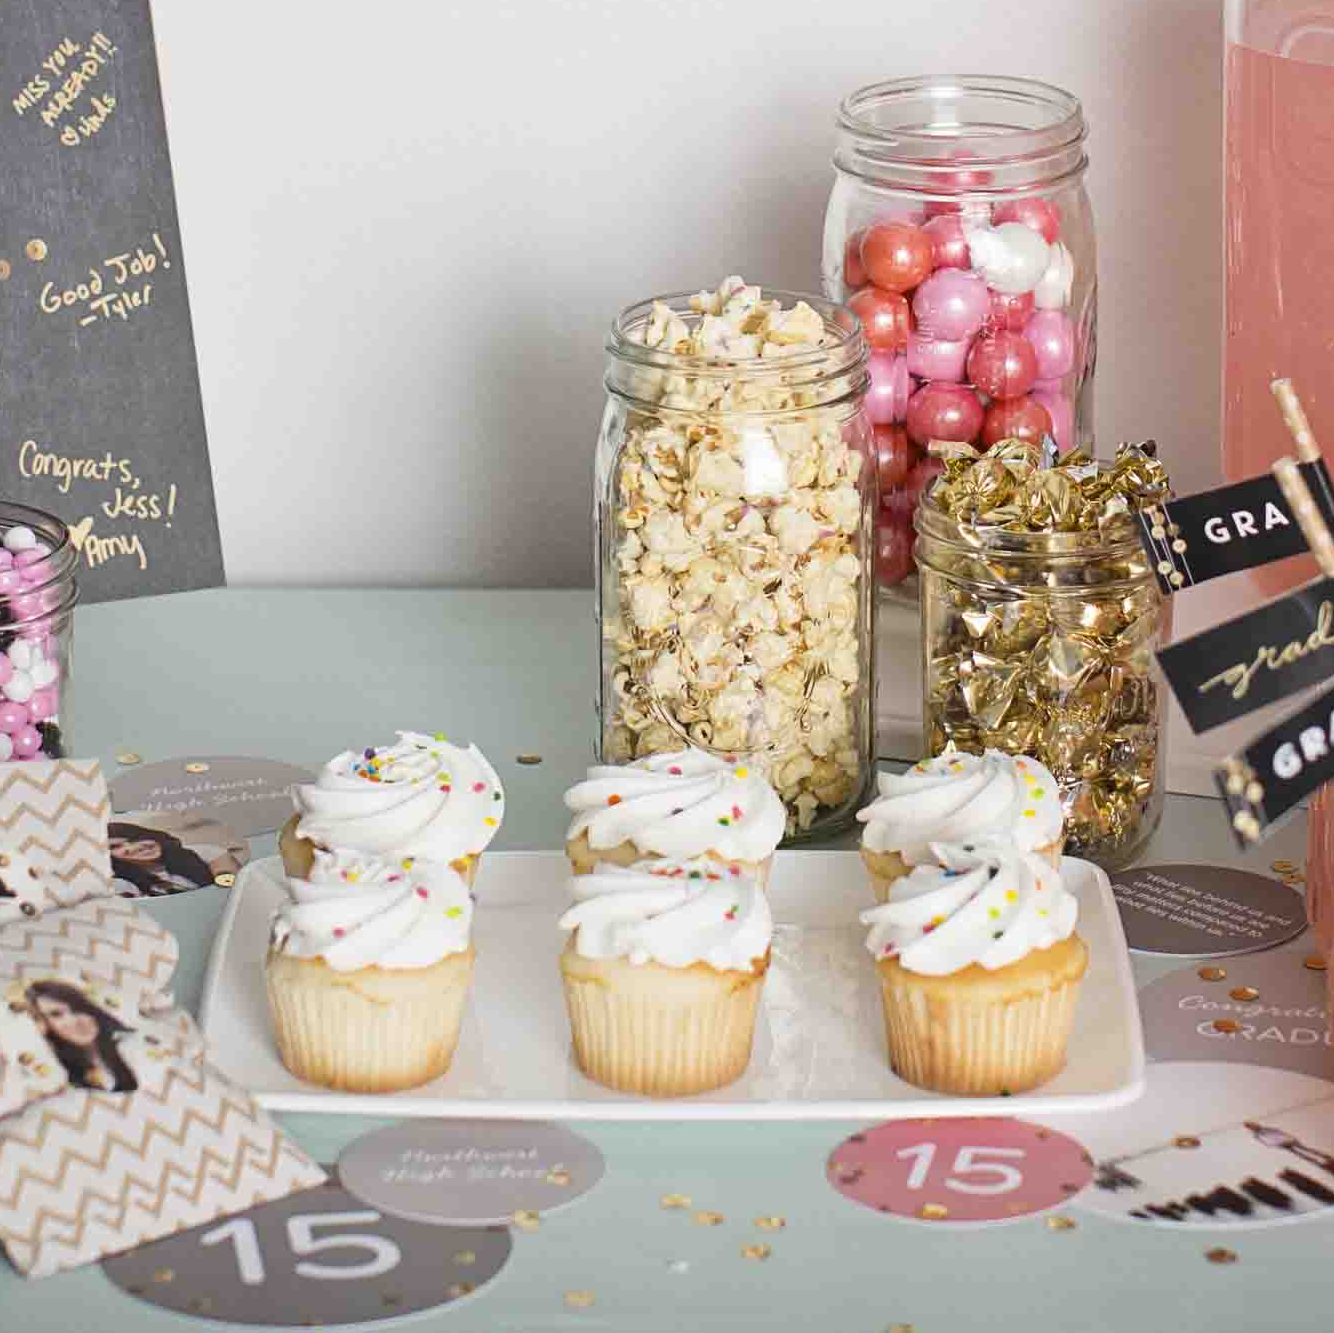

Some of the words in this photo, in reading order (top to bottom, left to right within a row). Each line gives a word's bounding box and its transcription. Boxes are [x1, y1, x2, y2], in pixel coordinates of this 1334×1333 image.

[12, 73, 50, 115] MISS
[41, 269, 102, 314] Good
[101, 483, 177, 528] Jess!
[1204, 501, 1291, 544] GRA
[84, 534, 147, 570] Amy
[895, 1142, 1027, 1196] 15
[200, 1209, 402, 1286] 15
